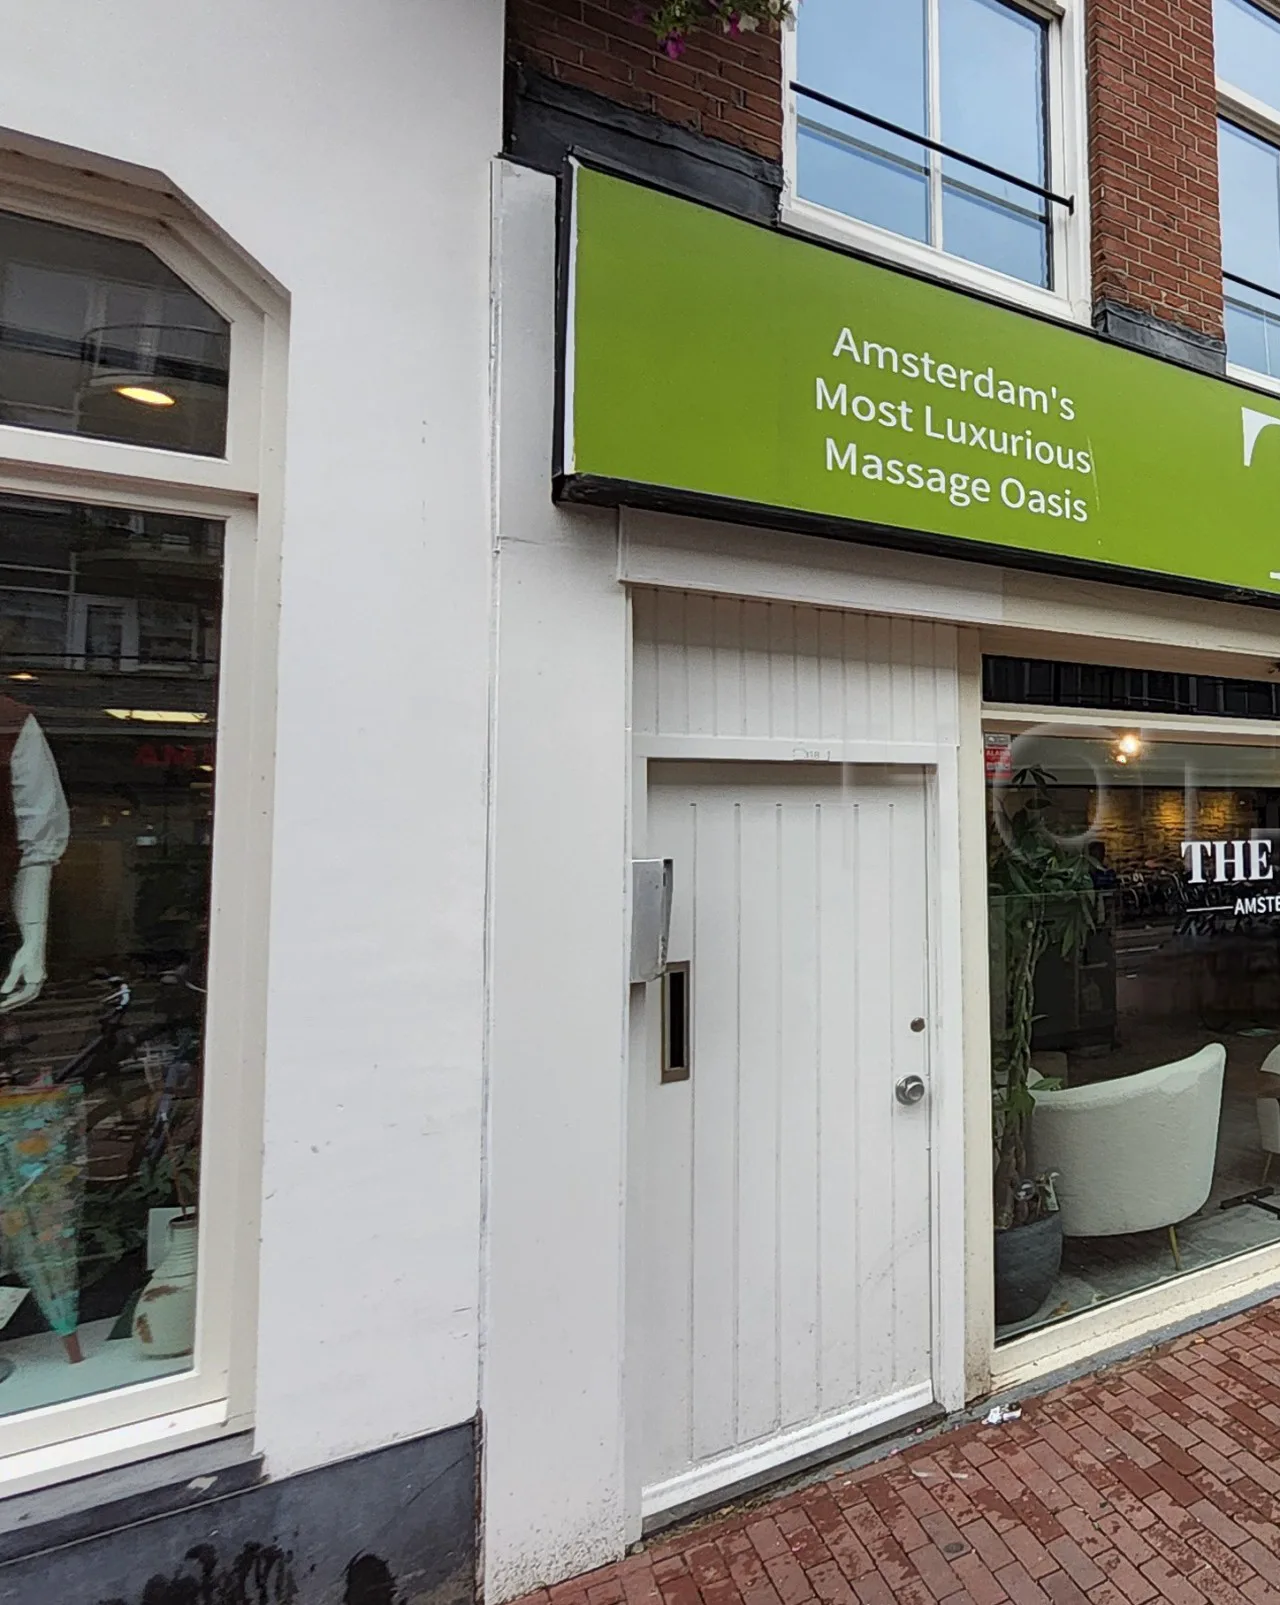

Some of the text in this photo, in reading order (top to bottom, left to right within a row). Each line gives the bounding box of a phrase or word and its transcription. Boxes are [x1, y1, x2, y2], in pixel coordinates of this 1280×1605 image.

[832, 326, 1075, 422] Amsterdam's
[815, 376, 1092, 475] Most Luxurious
[825, 437, 1088, 523] Massage Oasis
[1180, 839, 1274, 884] THE
